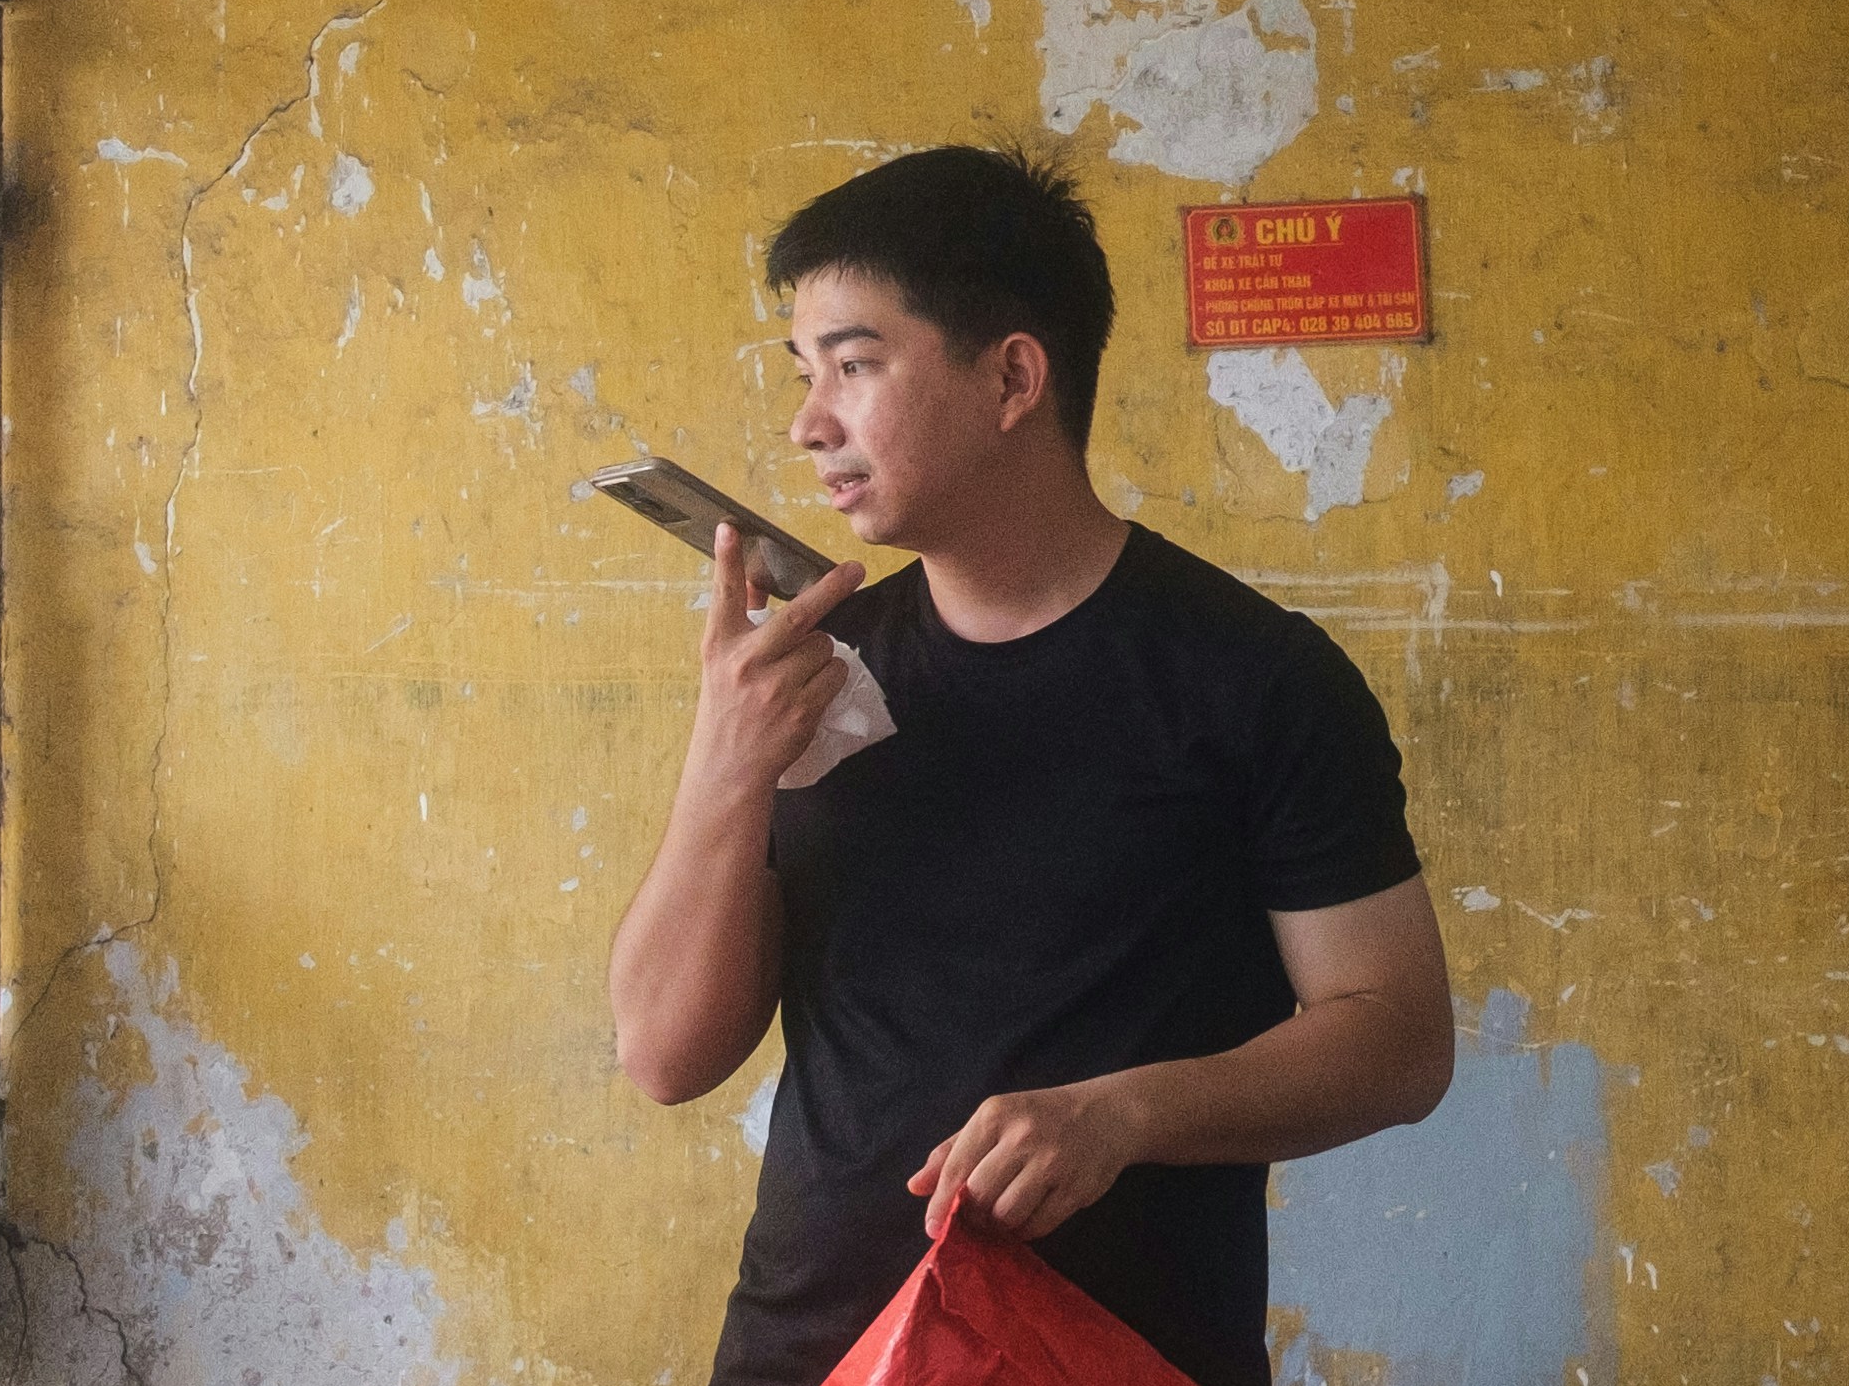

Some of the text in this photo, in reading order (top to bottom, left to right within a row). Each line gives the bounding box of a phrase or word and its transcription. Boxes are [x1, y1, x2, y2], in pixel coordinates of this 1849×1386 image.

[1255, 210, 1343, 245] CHÚ Ý
[1221, 255, 1236, 270] XE
[1238, 277, 1252, 291] XE
[1300, 315, 1327, 333] 028
[1332, 314, 1350, 332] 39
[1354, 313, 1382, 331] 404
